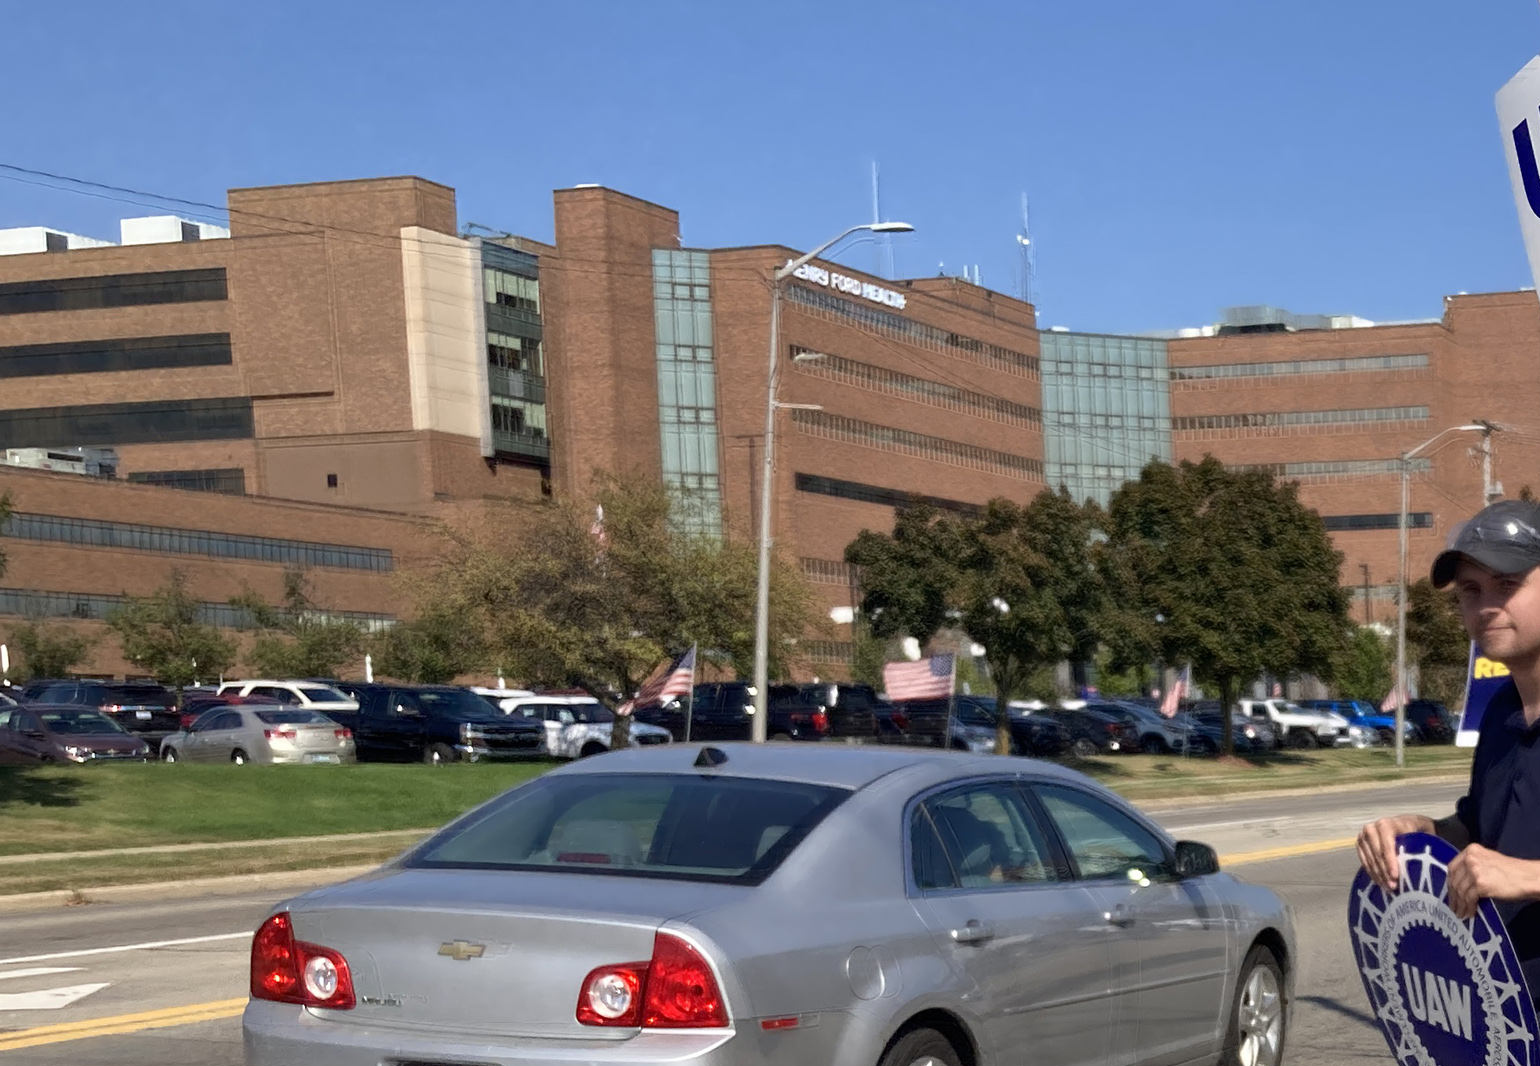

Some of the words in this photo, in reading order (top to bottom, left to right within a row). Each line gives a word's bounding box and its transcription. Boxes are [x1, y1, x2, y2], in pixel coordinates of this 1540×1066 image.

[830, 272, 861, 296] FORD
[1395, 899, 1428, 918] AMERICA
[1428, 900, 1459, 936] UNITED
[1401, 961, 1473, 1042] UAW
